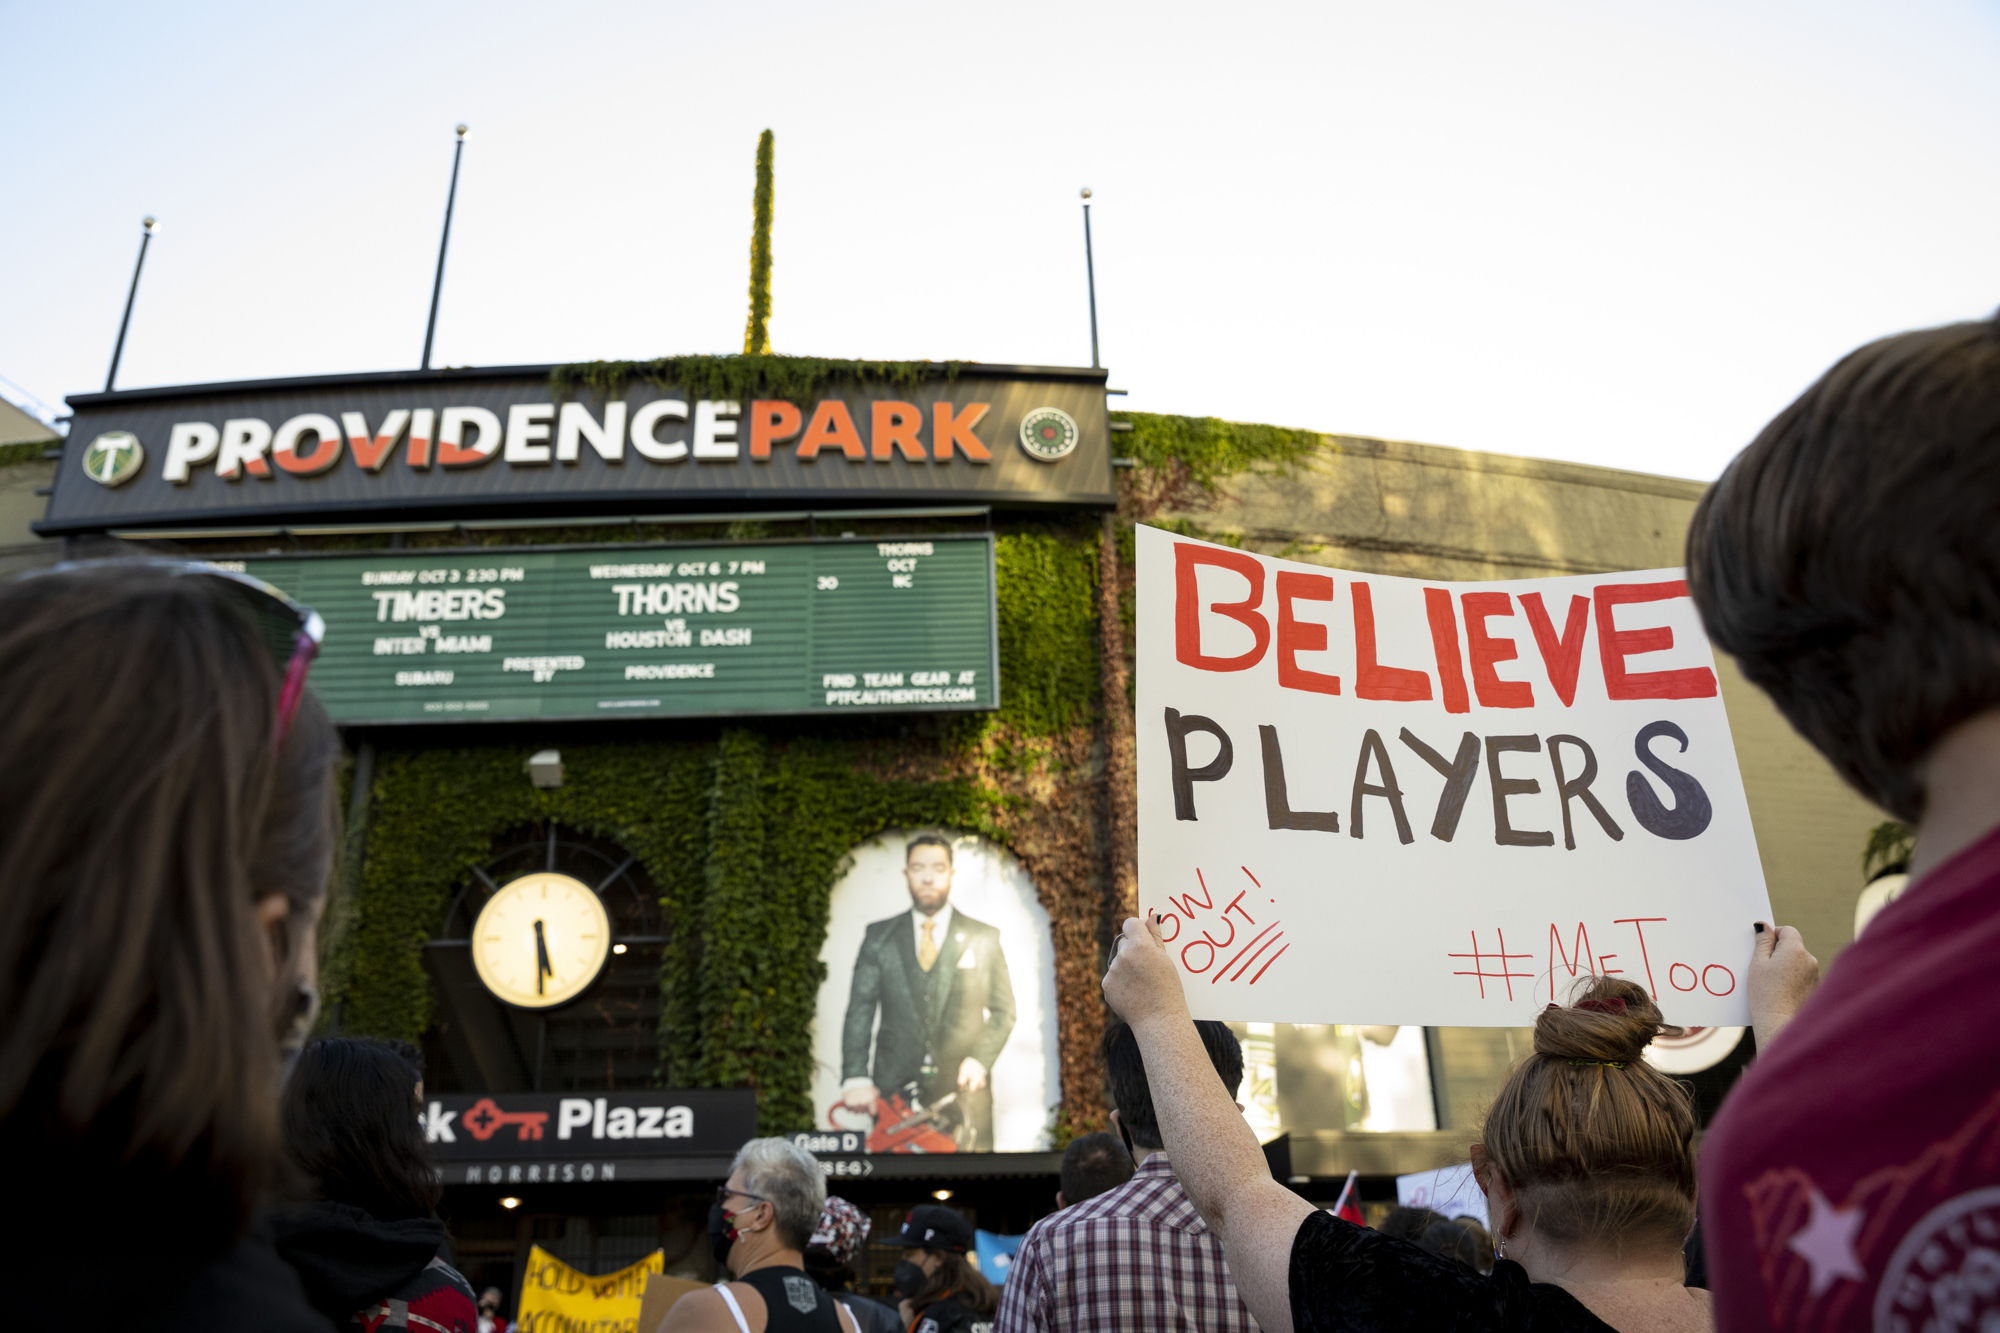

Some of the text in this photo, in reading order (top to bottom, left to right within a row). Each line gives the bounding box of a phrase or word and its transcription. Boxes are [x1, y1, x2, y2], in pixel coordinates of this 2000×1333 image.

[877, 542, 934, 557] THORNS
[590, 560, 766, 579] WEDNESDAY OCT 6 7 PM
[887, 558, 917, 573] OCT
[361, 571, 416, 586] SUNDAY
[418, 569, 447, 584] OCT
[449, 569, 461, 583] 3
[500, 567, 525, 582] PM
[816, 576, 839, 591] 30
[371, 588, 506, 622] TIMBERS
[611, 581, 741, 616] THORNS
[419, 625, 441, 640] VS
[664, 618, 687, 633] VS
[1174, 541, 1718, 714] BELIEVE
[373, 635, 493, 655] INTER MIAMI
[605, 628, 752, 649] HOUSTON DASH
[502, 655, 586, 672] PRESENTED
[625, 663, 715, 680] PROVIDENCE
[395, 670, 454, 686] SUBARU
[532, 671, 556, 683] BY
[822, 670, 976, 689] FIND TEAM GEAR AT
[1164, 705, 1713, 851] PLAYERS
[557, 1098, 694, 1140] Plaza
[842, 1133, 859, 1152] D
[466, 1163, 616, 1184] MORRISON
